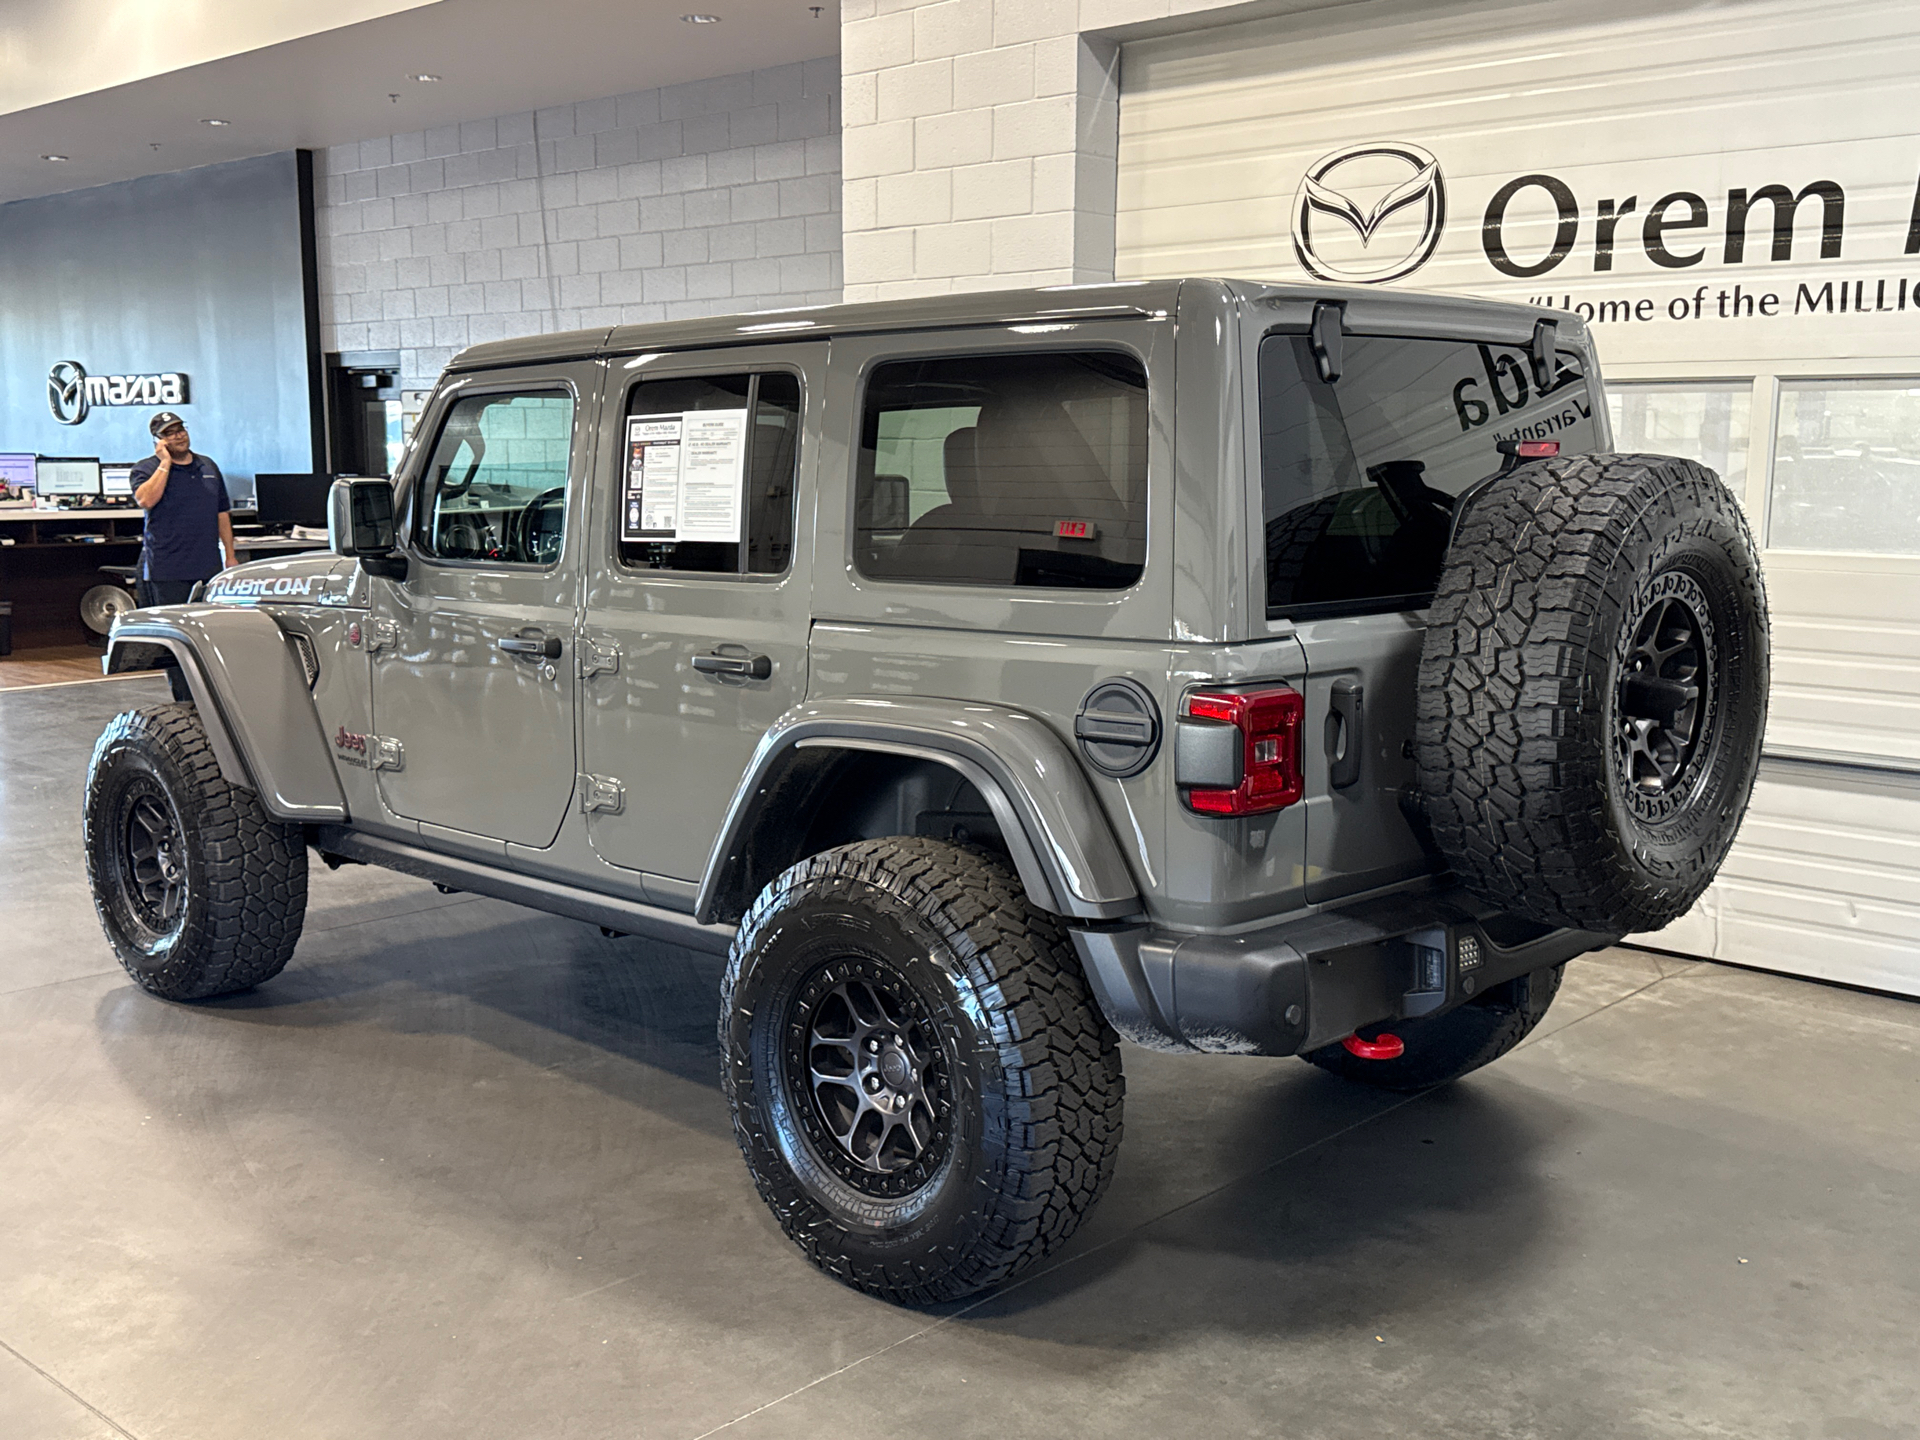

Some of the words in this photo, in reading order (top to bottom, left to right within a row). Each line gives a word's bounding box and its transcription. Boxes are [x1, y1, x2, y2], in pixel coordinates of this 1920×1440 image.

[1482, 174, 1845, 278] Orem
[1668, 286, 1708, 320] of
[1717, 285, 1780, 318] the
[1794, 278, 1920, 315] MILLI
[84, 373, 186, 406] mazda
[211, 577, 312, 596] RUBICON
[335, 726, 367, 757] Jeep
